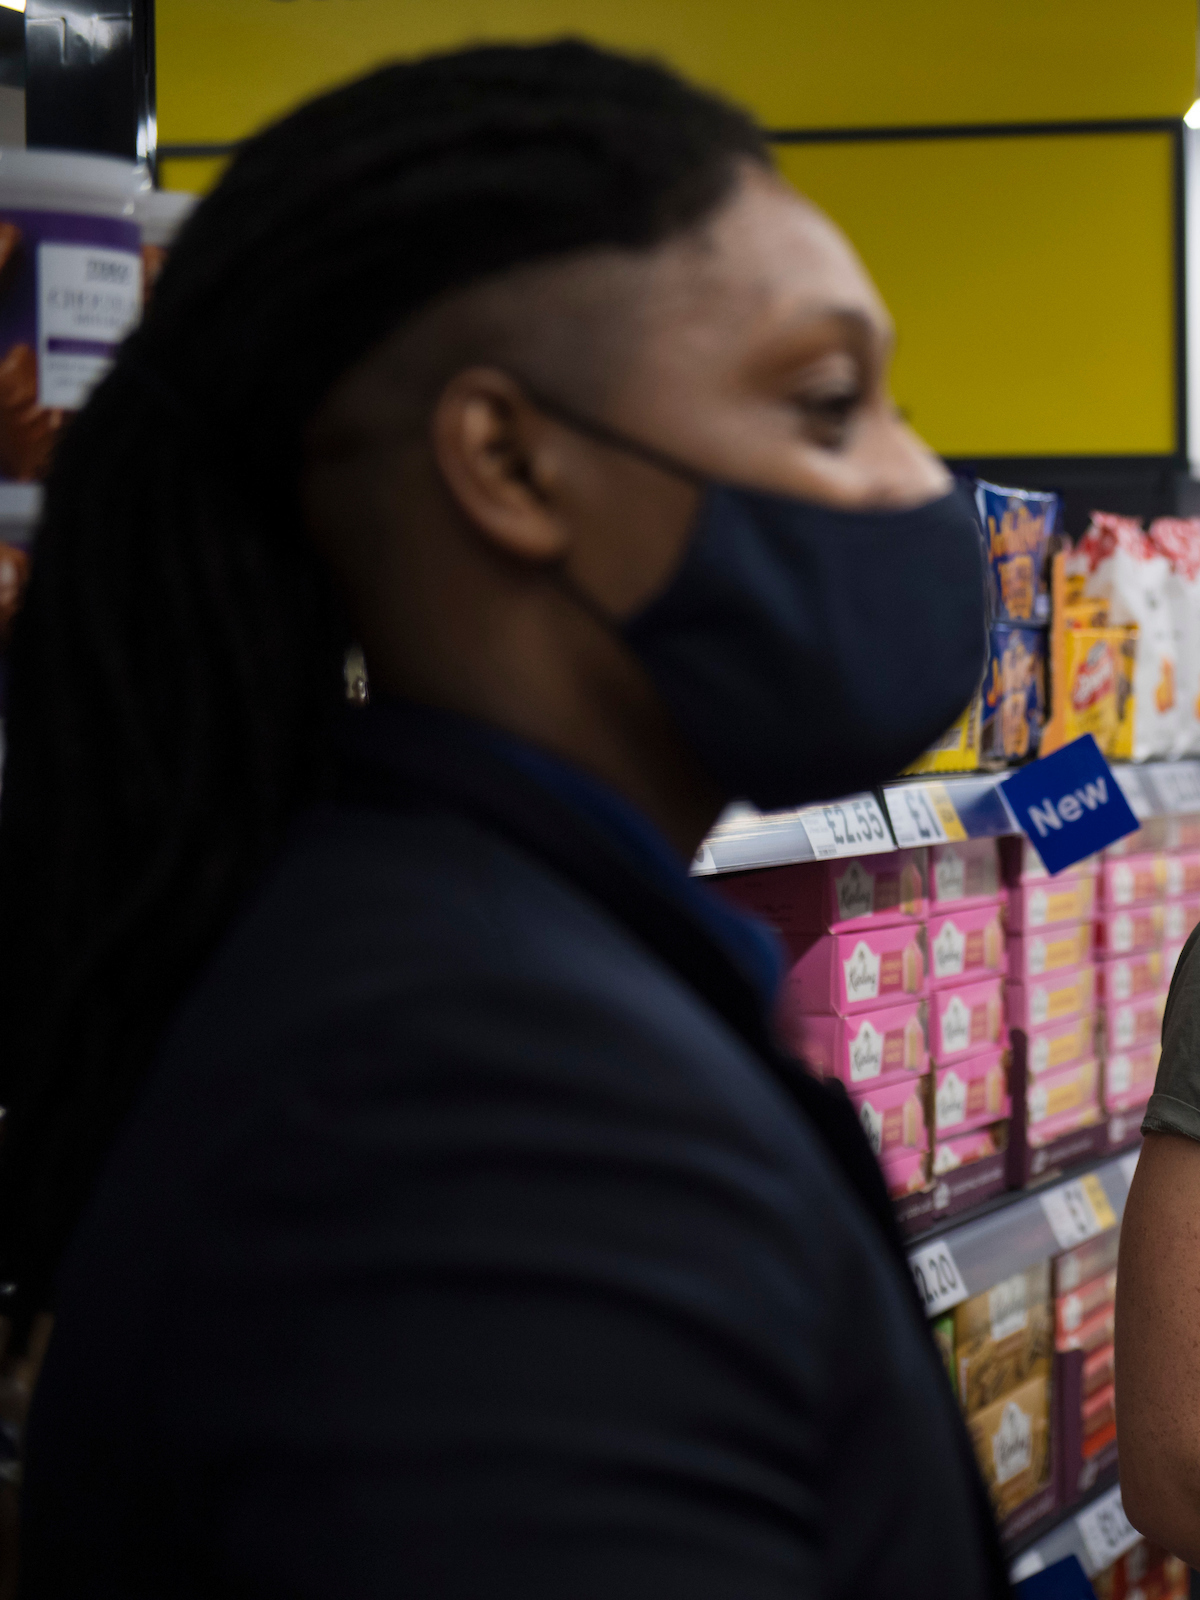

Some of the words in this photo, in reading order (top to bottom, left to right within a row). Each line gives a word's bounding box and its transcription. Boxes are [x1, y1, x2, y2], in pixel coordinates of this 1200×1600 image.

[823, 801, 885, 845] £2.55
[904, 790, 941, 838] £1
[1027, 776, 1109, 838] New
